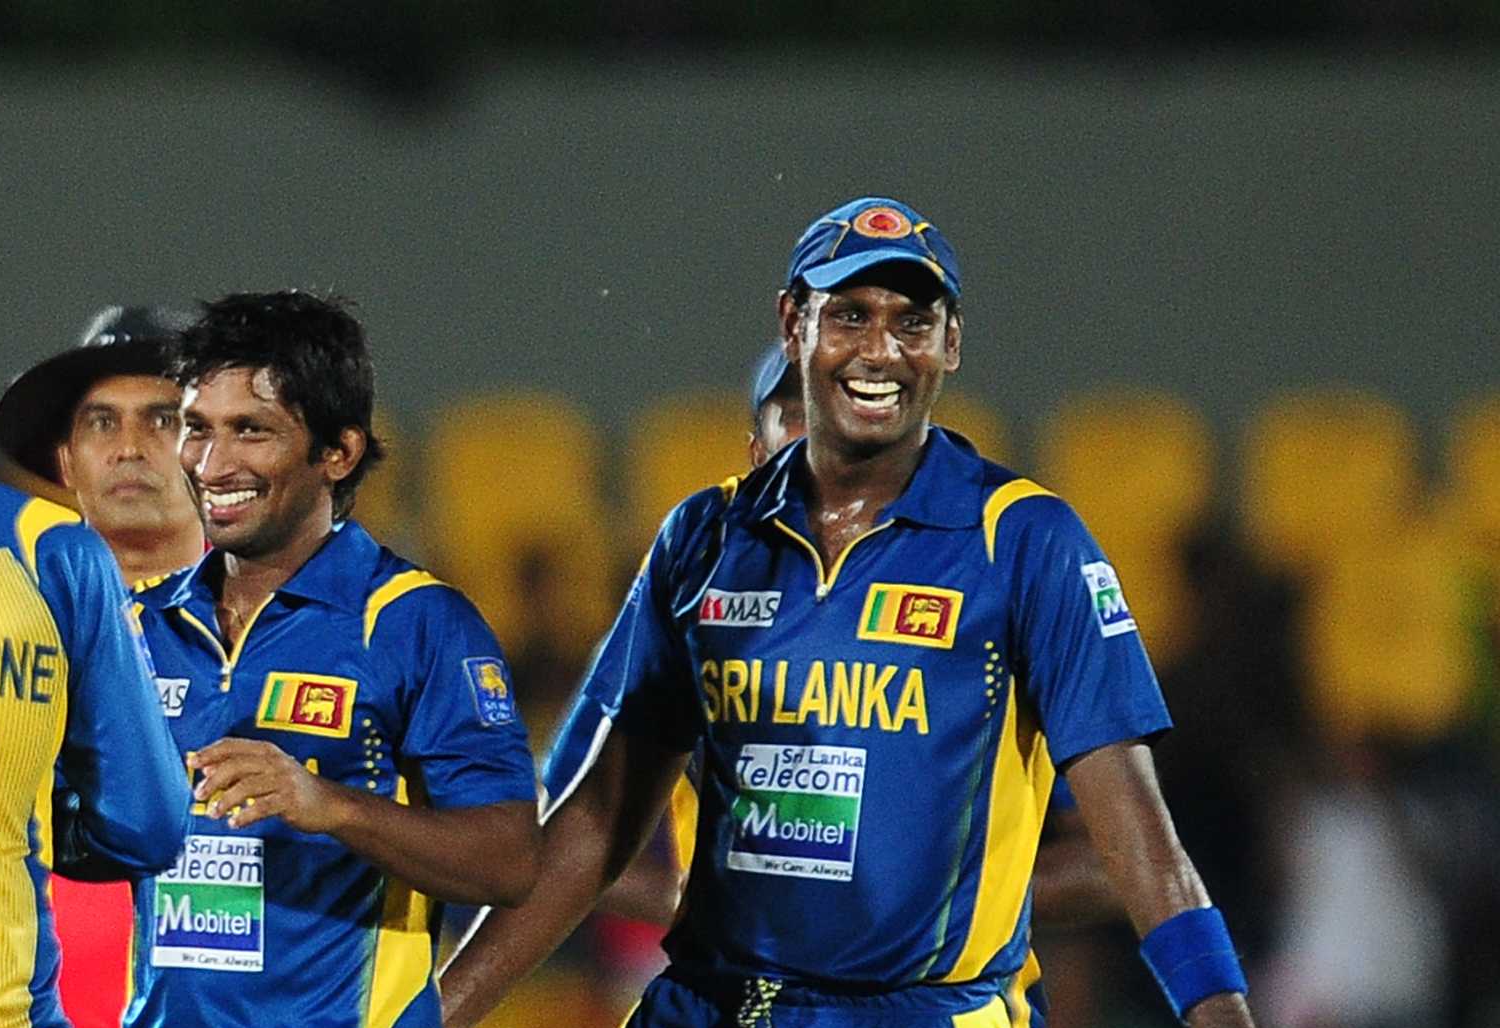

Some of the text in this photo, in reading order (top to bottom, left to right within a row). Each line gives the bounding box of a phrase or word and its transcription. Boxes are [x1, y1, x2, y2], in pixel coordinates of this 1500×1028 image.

[702, 659, 930, 736] SRI LANKA
[740, 753, 861, 794] Telecom
[809, 749, 864, 768] Lanka
[741, 801, 846, 846] Mobitel
[189, 838, 213, 855] Sri
[159, 893, 252, 936] Mobitel
